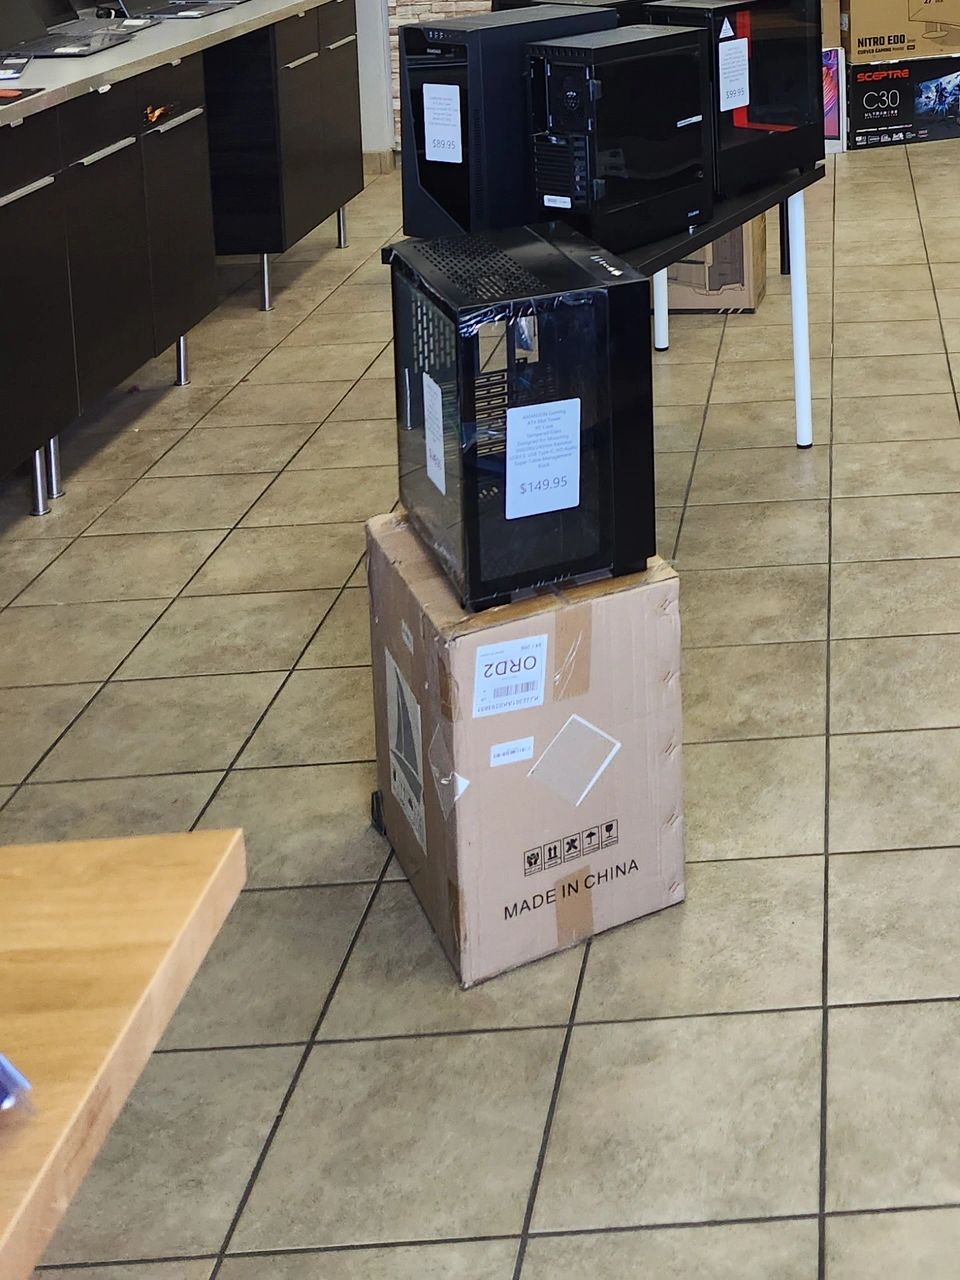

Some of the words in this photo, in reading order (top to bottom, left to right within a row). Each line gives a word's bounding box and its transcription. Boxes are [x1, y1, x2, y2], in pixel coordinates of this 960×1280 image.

[857, 36, 885, 49] NITRO
[857, 68, 910, 82] SCEPTRE
[726, 87, 745, 100] $99.95
[862, 89, 900, 110] C30
[432, 138, 456, 150] $89.95
[519, 475, 568, 496] $149.95
[483, 655, 537, 679] ORD2
[503, 888, 557, 921] MADE
[562, 879, 579, 898] IN
[583, 858, 639, 890] CHINA
